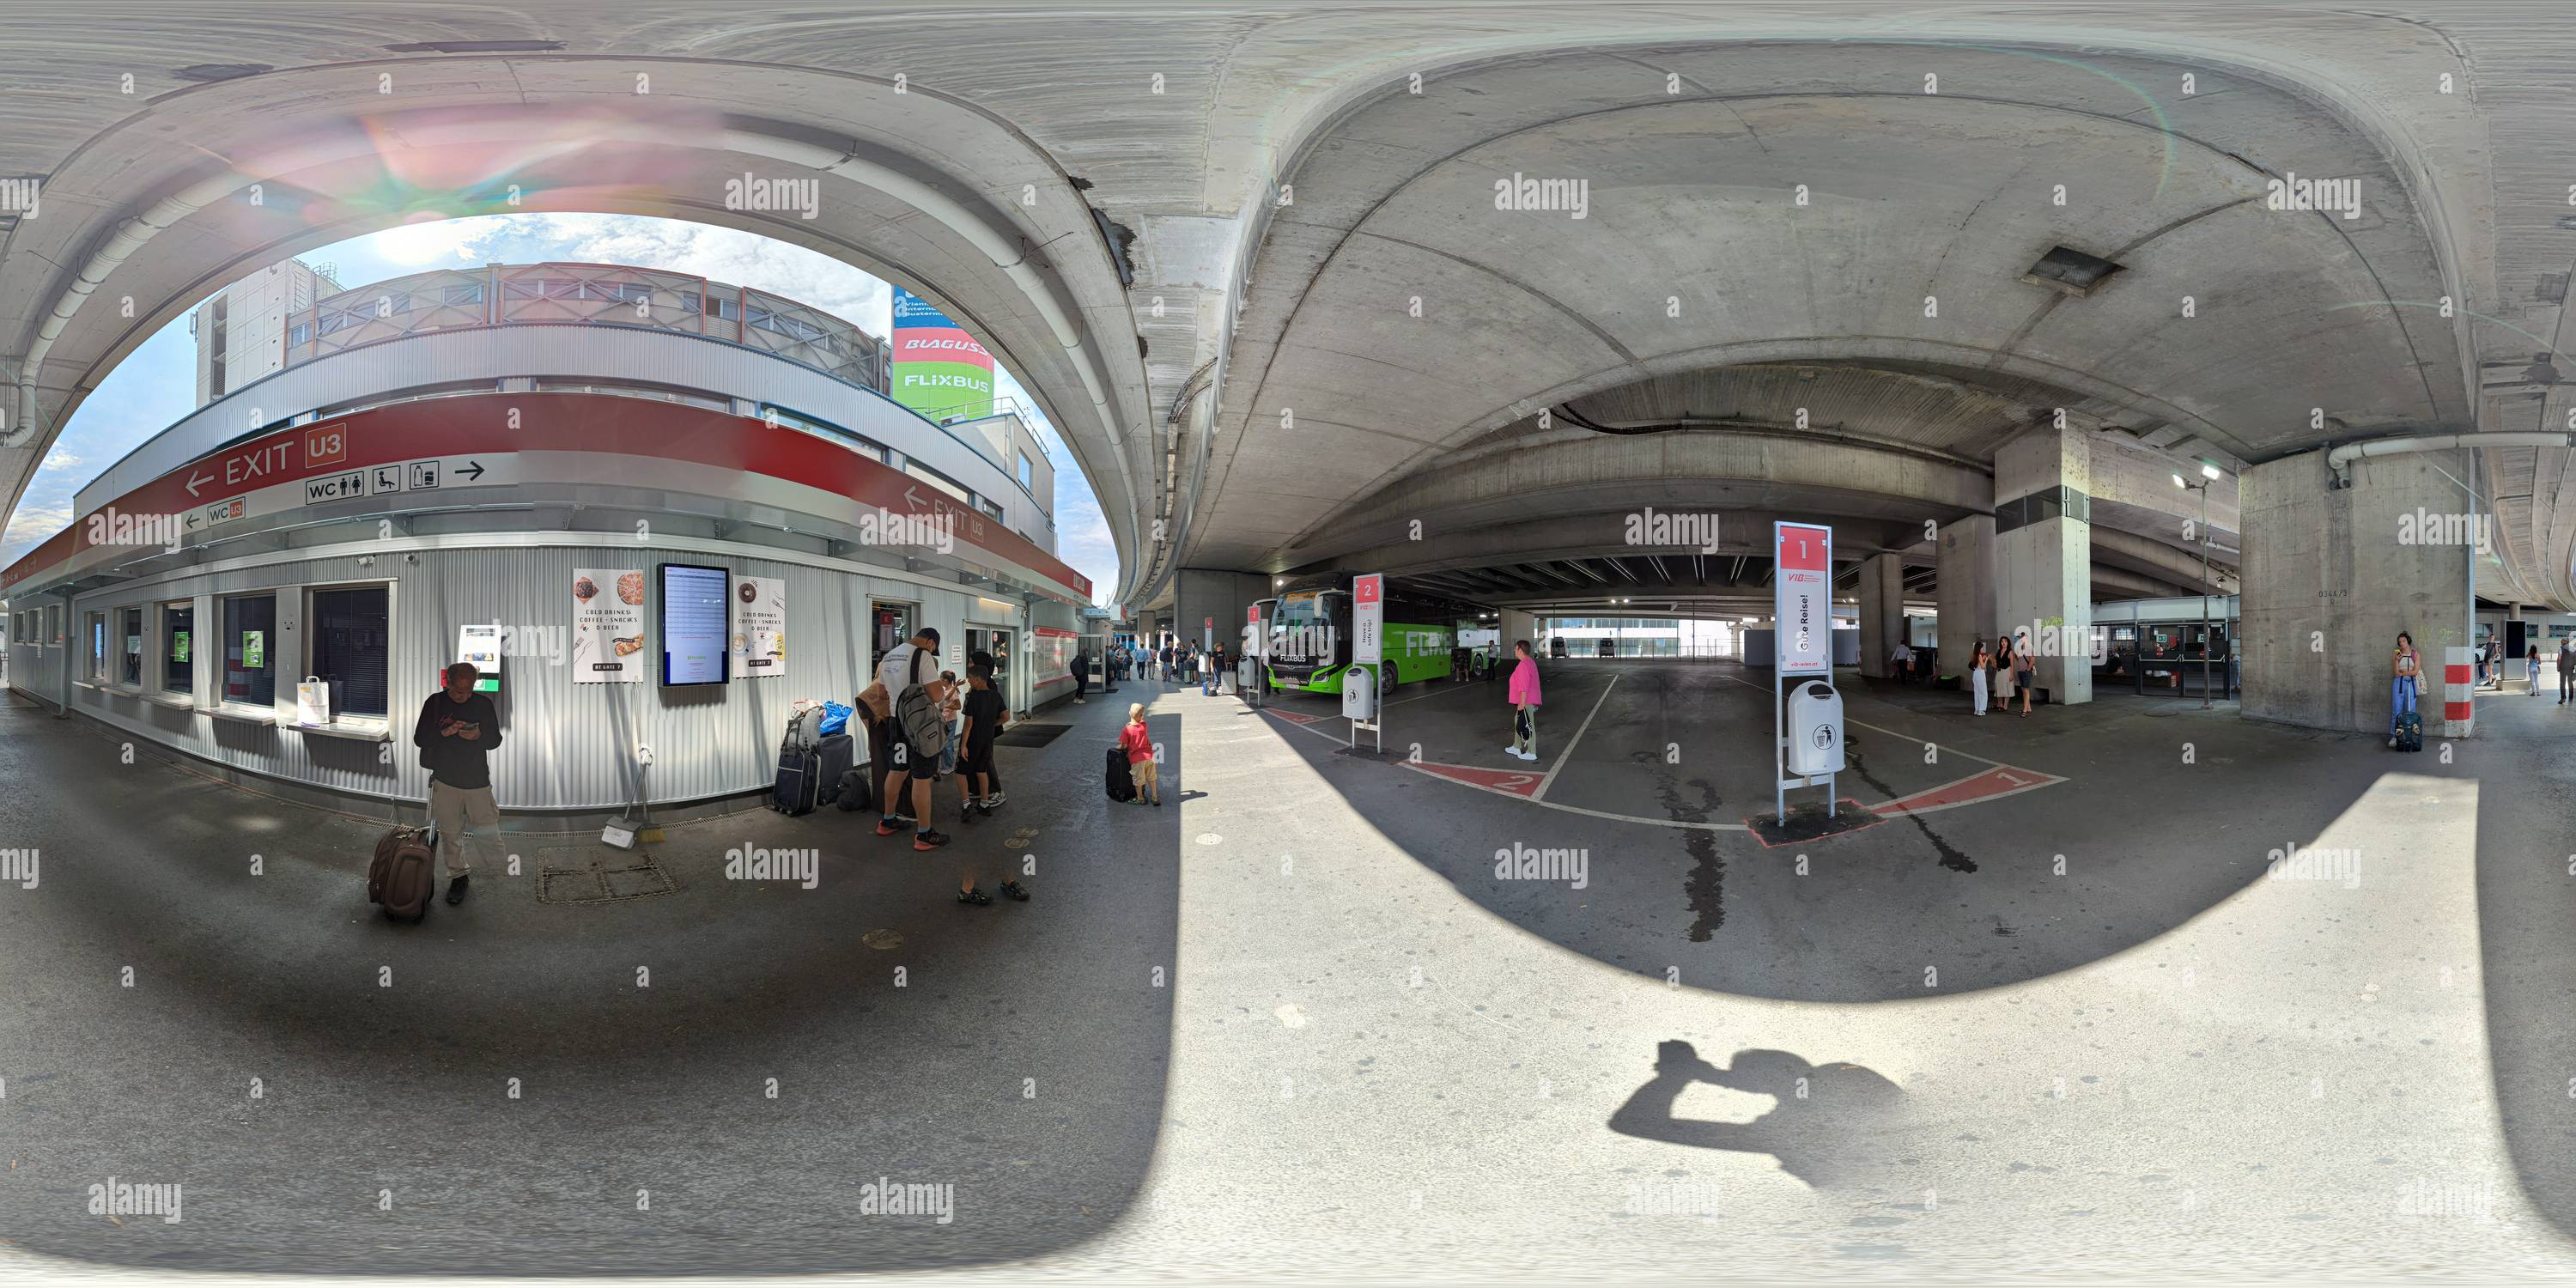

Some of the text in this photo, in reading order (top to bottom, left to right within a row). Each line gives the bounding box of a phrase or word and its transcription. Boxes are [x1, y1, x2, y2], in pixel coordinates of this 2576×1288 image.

[227, 433, 342, 485] EXIT U3
[310, 483, 337, 498] WC
[210, 502, 242, 521] WC U3
[934, 499, 982, 537] EXIT U3
[1800, 540, 1807, 559] 1
[1789, 574, 1804, 582] VIB
[1364, 585, 1371, 596] 2
[1800, 594, 1808, 650] Gute Reise!
[1493, 775, 1534, 792] 2
[1996, 772, 2034, 787] 1
